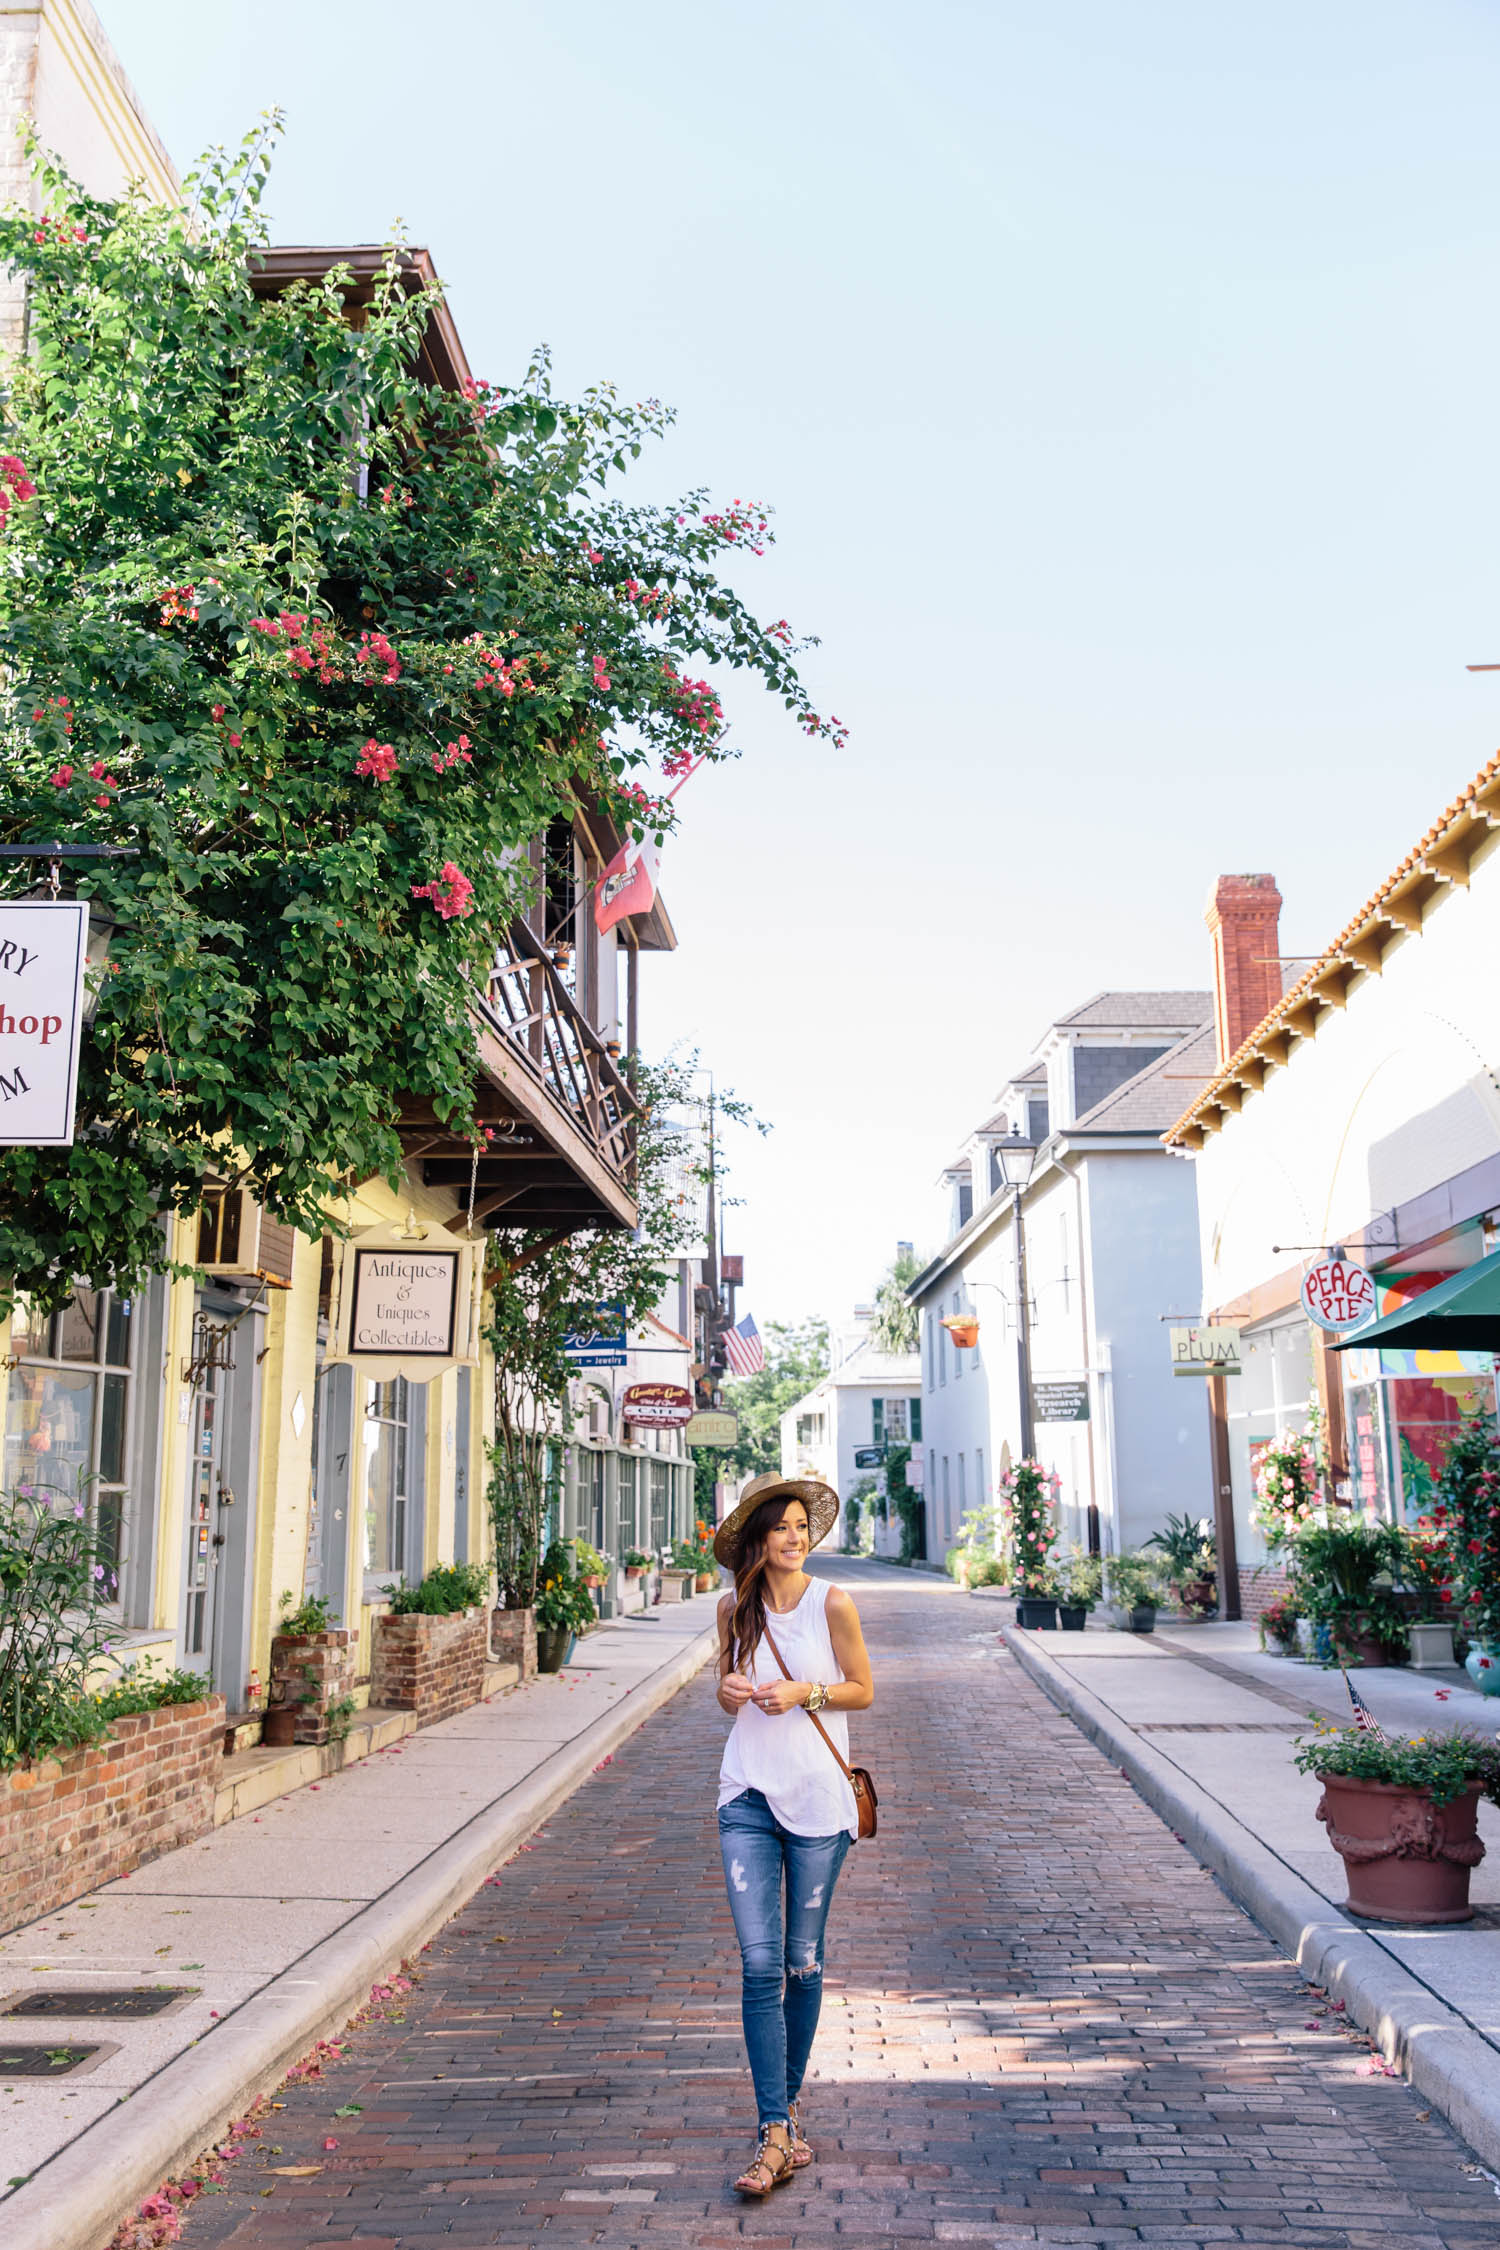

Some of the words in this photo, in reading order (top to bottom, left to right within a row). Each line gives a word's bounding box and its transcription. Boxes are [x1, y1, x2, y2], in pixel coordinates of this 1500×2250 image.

[0, 939, 39, 976] RY
[367, 1259, 447, 1283] Antiques
[397, 1284, 412, 1301] &
[1305, 1261, 1373, 1306] PEACE
[376, 1303, 431, 1325] Uniques
[1320, 1297, 1362, 1321] PIE
[358, 1328, 446, 1346] Collectibles
[1177, 1328, 1237, 1360] PLUM
[595, 1356, 622, 1365] Jewelry
[1037, 1399, 1081, 1408] Research
[1041, 1407, 1078, 1417] Library
[336, 1452, 348, 1476] 7
